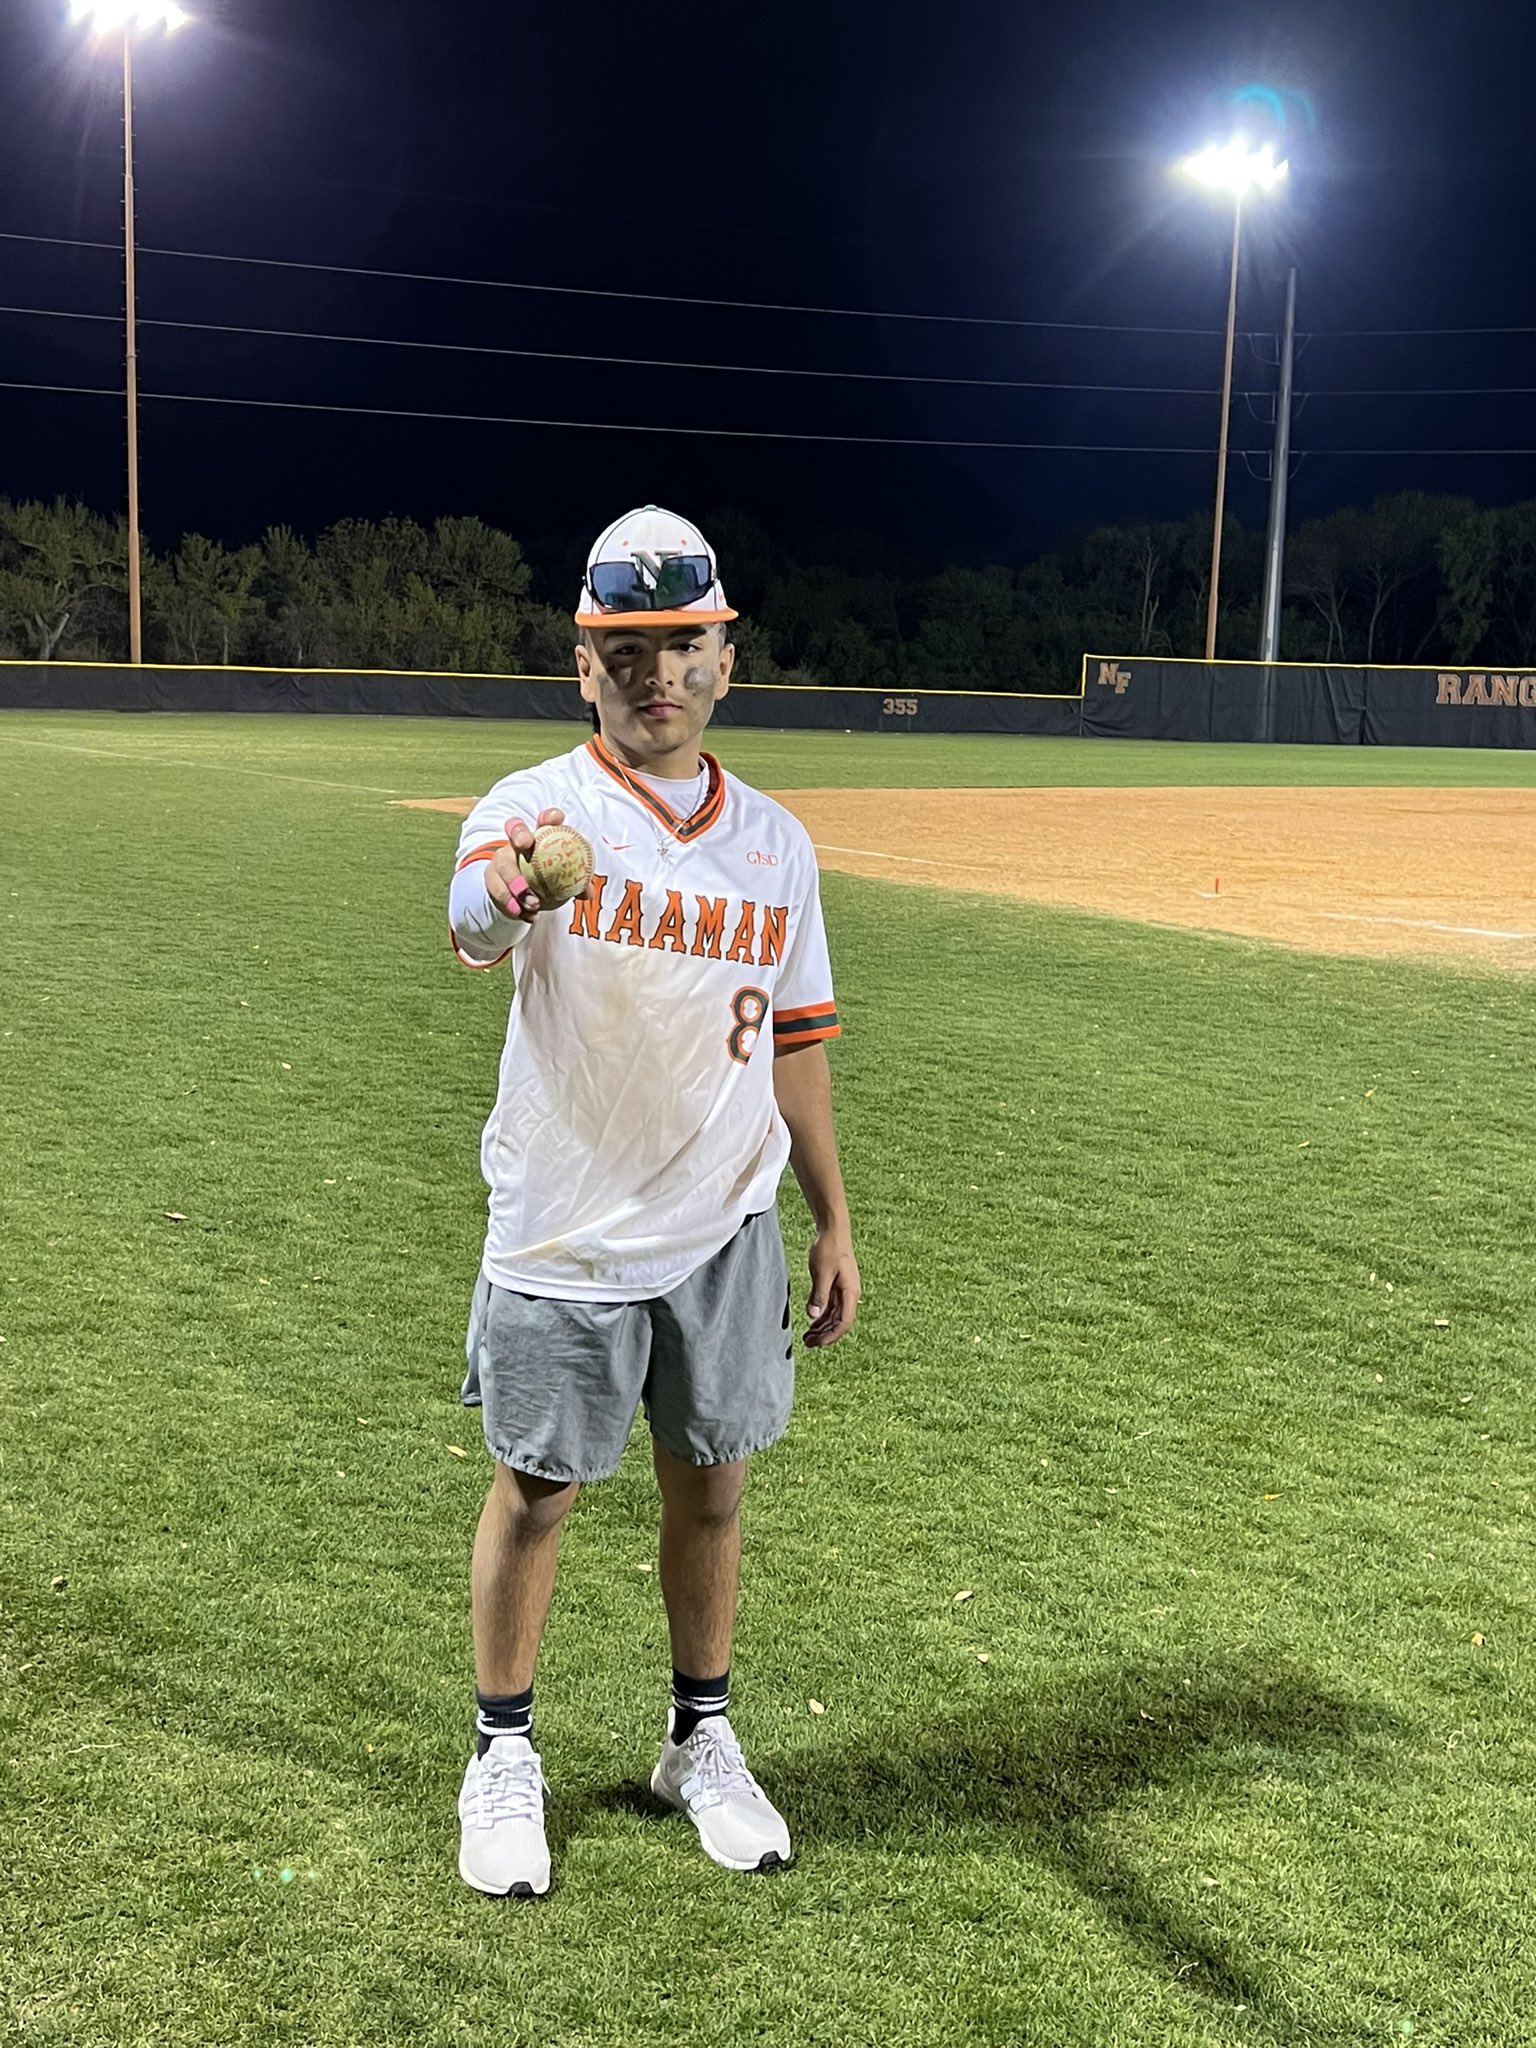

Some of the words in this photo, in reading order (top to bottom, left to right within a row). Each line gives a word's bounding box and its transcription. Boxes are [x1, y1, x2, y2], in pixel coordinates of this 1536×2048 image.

[1098, 662, 1131, 694] NF
[1436, 674, 1536, 706] RANG
[883, 698, 918, 715] 355
[569, 874, 788, 966] NAAMAN
[726, 986, 770, 1066] 8
